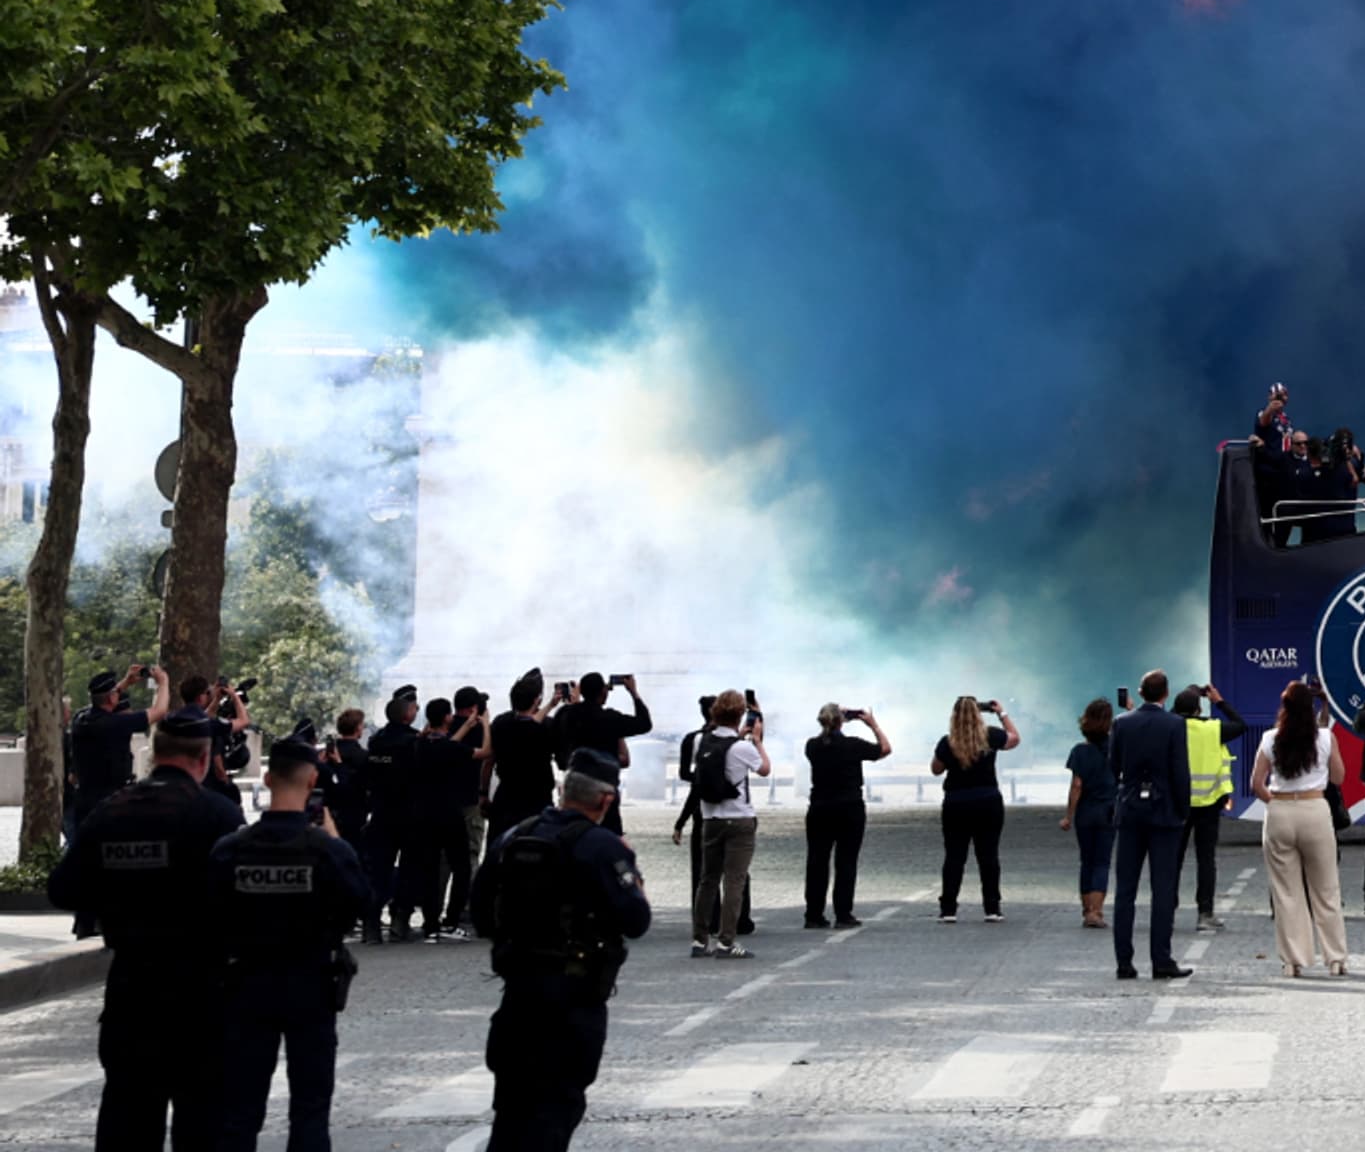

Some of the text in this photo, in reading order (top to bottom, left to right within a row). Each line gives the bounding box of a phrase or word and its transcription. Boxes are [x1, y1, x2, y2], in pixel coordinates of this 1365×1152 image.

[1245, 647, 1298, 663] QATAR
[106, 844, 162, 860] POLICE
[239, 868, 307, 885] POLICE
